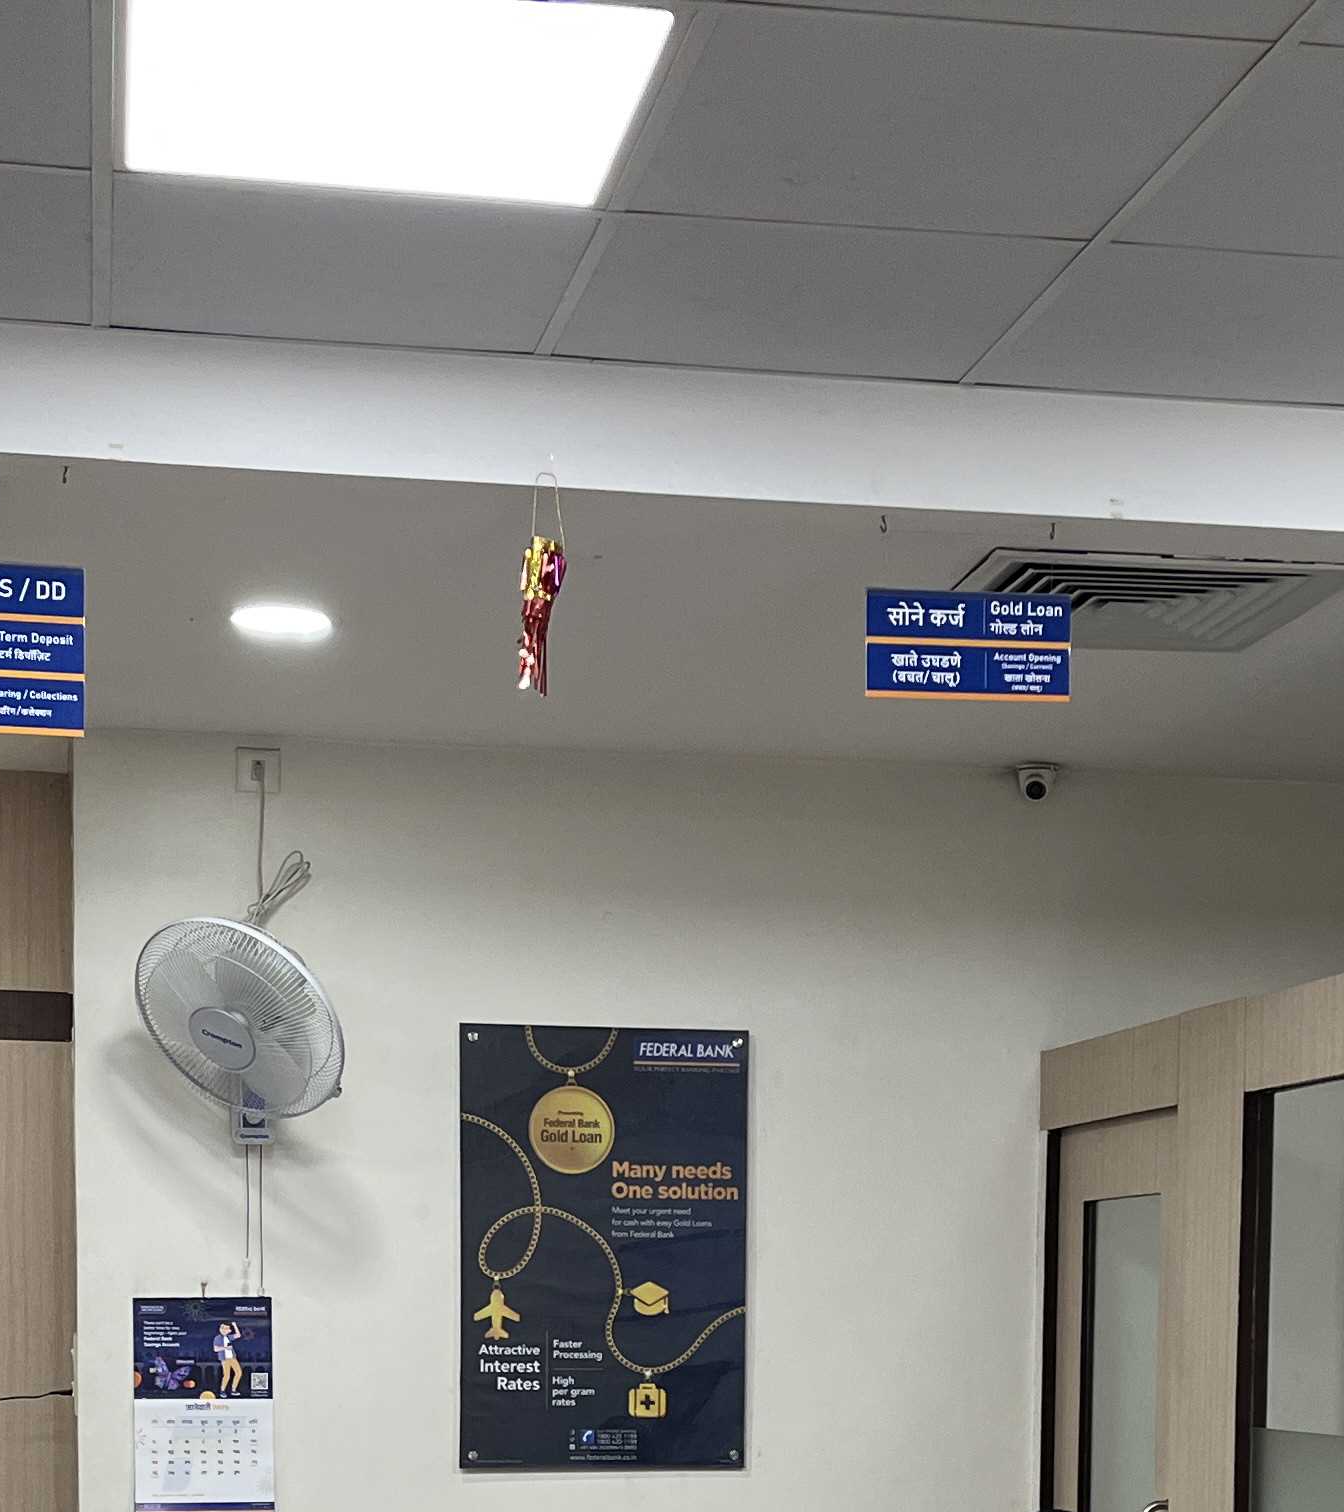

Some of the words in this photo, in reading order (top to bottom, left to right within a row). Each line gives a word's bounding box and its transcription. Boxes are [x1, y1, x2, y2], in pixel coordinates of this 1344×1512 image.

[19, 577, 31, 602] /
[35, 580, 67, 601] DD
[887, 602, 925, 627] सोने
[929, 603, 966, 628] कर्ज
[990, 601, 1023, 616] Gold
[1027, 602, 1063, 617] Loan
[989, 621, 1017, 636] गोल्ड
[1020, 620, 1043, 636] लोन
[31, 632, 74, 647] Deposit
[890, 649, 918, 667] खाते
[920, 651, 962, 668] उघडणे
[994, 652, 1027, 661] Account
[1028, 652, 1062, 665] Opening
[29, 690, 79, 702] Collections
[639, 1041, 694, 1058] FEDERAL
[696, 1043, 735, 1059] BANK
[543, 1118, 576, 1128] Federal
[578, 1119, 600, 1129] Bank
[540, 1129, 569, 1143] Gold
[572, 1130, 603, 1144] Loan
[612, 1160, 666, 1182] Many
[671, 1162, 733, 1180] needs
[611, 1181, 654, 1199] One
[658, 1182, 739, 1200] solution
[611, 1206, 631, 1216] Meet
[632, 1208, 648, 1216] your
[478, 1343, 541, 1356] Attractive
[552, 1338, 583, 1349] Faster
[552, 1350, 603, 1362] Processing
[480, 1358, 541, 1374] Interest
[496, 1376, 541, 1391] Rates
[552, 1376, 575, 1388] High
[552, 1389, 567, 1398] per
[570, 1388, 595, 1398] gram
[552, 1398, 577, 1407] rates
